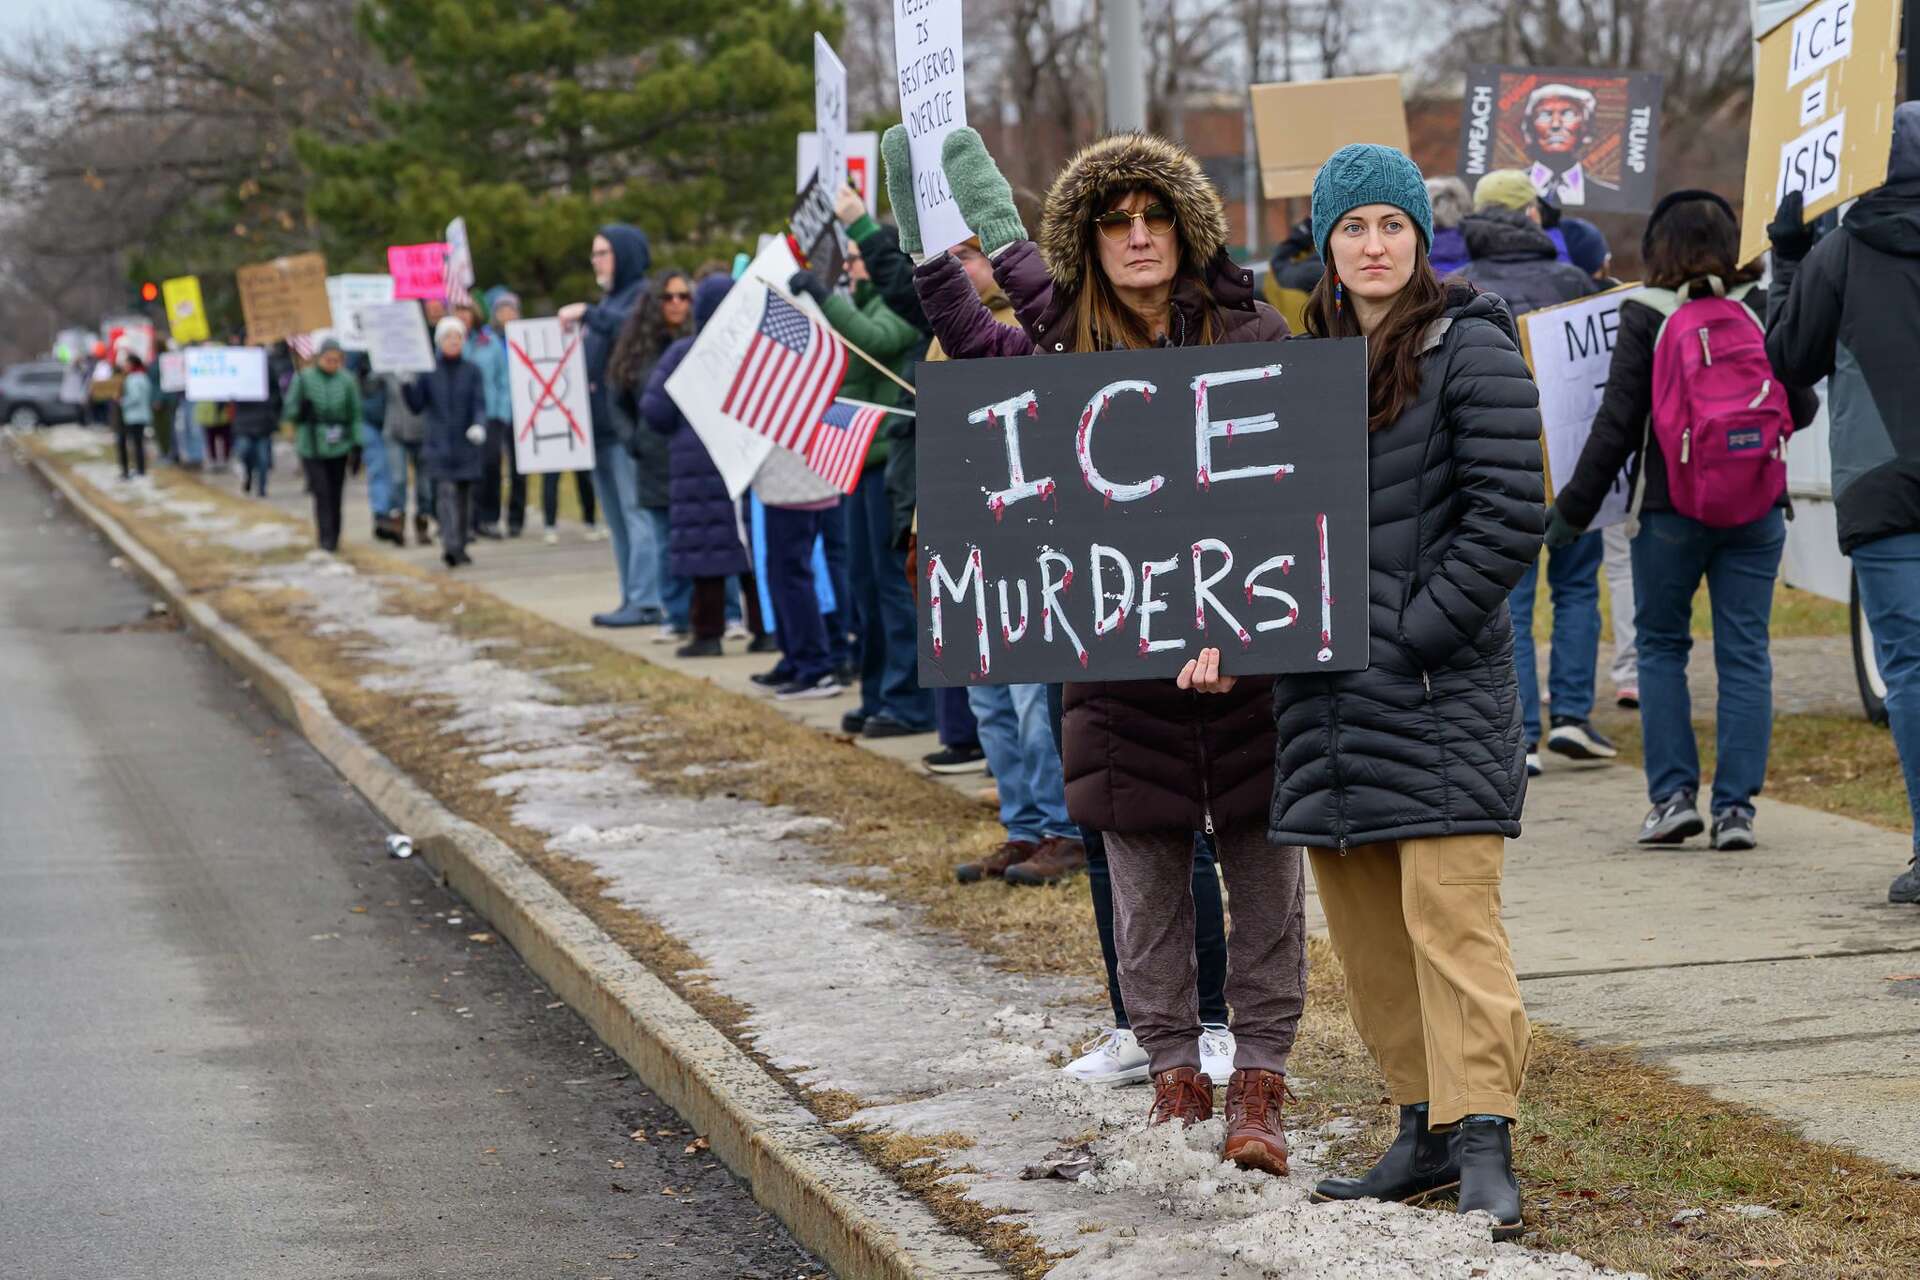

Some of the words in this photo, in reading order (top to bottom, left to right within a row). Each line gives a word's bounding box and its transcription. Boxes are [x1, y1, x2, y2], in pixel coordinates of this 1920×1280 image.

[916, 18, 929, 46] IS
[901, 58, 921, 97] BEST
[922, 46, 955, 85] SERVED
[910, 100, 935, 139] OVER
[934, 90, 953, 127] ICE
[1466, 86, 1493, 175] IMPEACH
[1627, 106, 1652, 174] TRUMP
[918, 170, 947, 211] FUCK
[967, 364, 1296, 516] ICE
[926, 512, 1335, 677] MURDERS!
